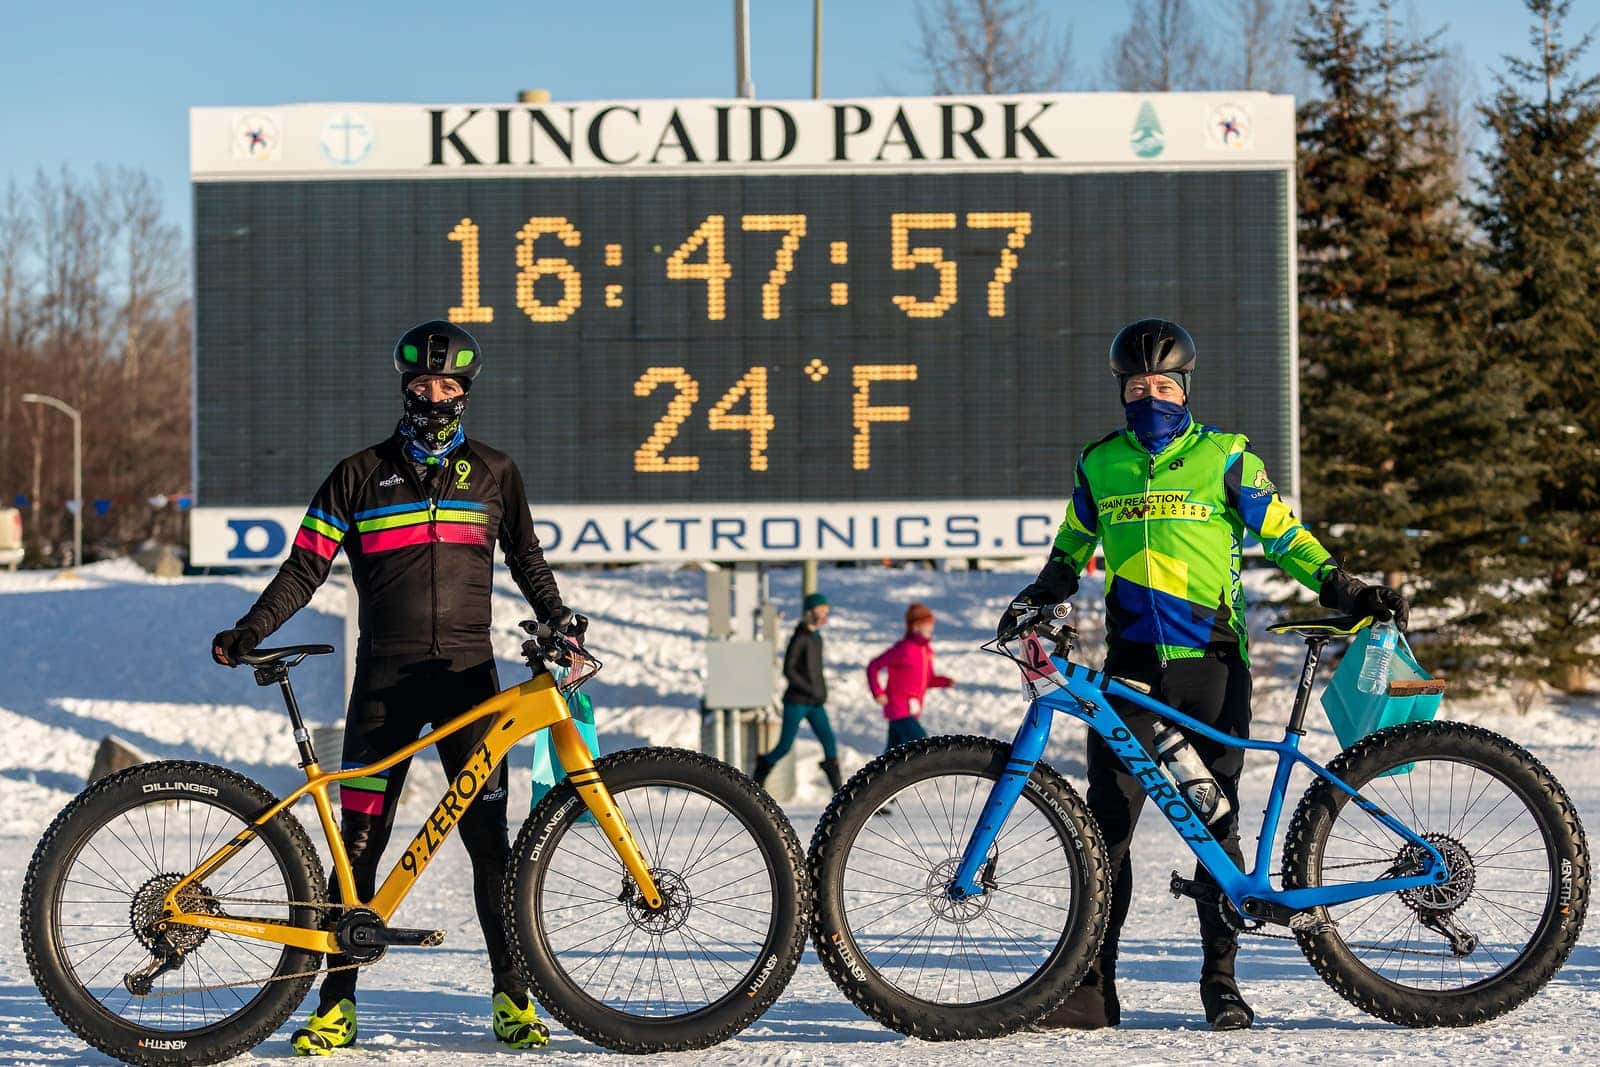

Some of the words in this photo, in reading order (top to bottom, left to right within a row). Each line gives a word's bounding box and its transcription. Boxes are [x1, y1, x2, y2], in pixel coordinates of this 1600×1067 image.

[428, 106, 798, 166] KINCAID
[829, 102, 1059, 161] PARK
[1124, 494, 1184, 507] REACTION
[534, 516, 1051, 552] DAKTRONICS.C
[142, 781, 219, 798] DILLINGER
[1026, 778, 1079, 838] DILLINGER
[529, 796, 577, 862] DILLINGER
[750, 953, 778, 993] 45NRTH
[835, 940, 867, 983] 45NRTH
[144, 1038, 188, 1050] 45NRTH
